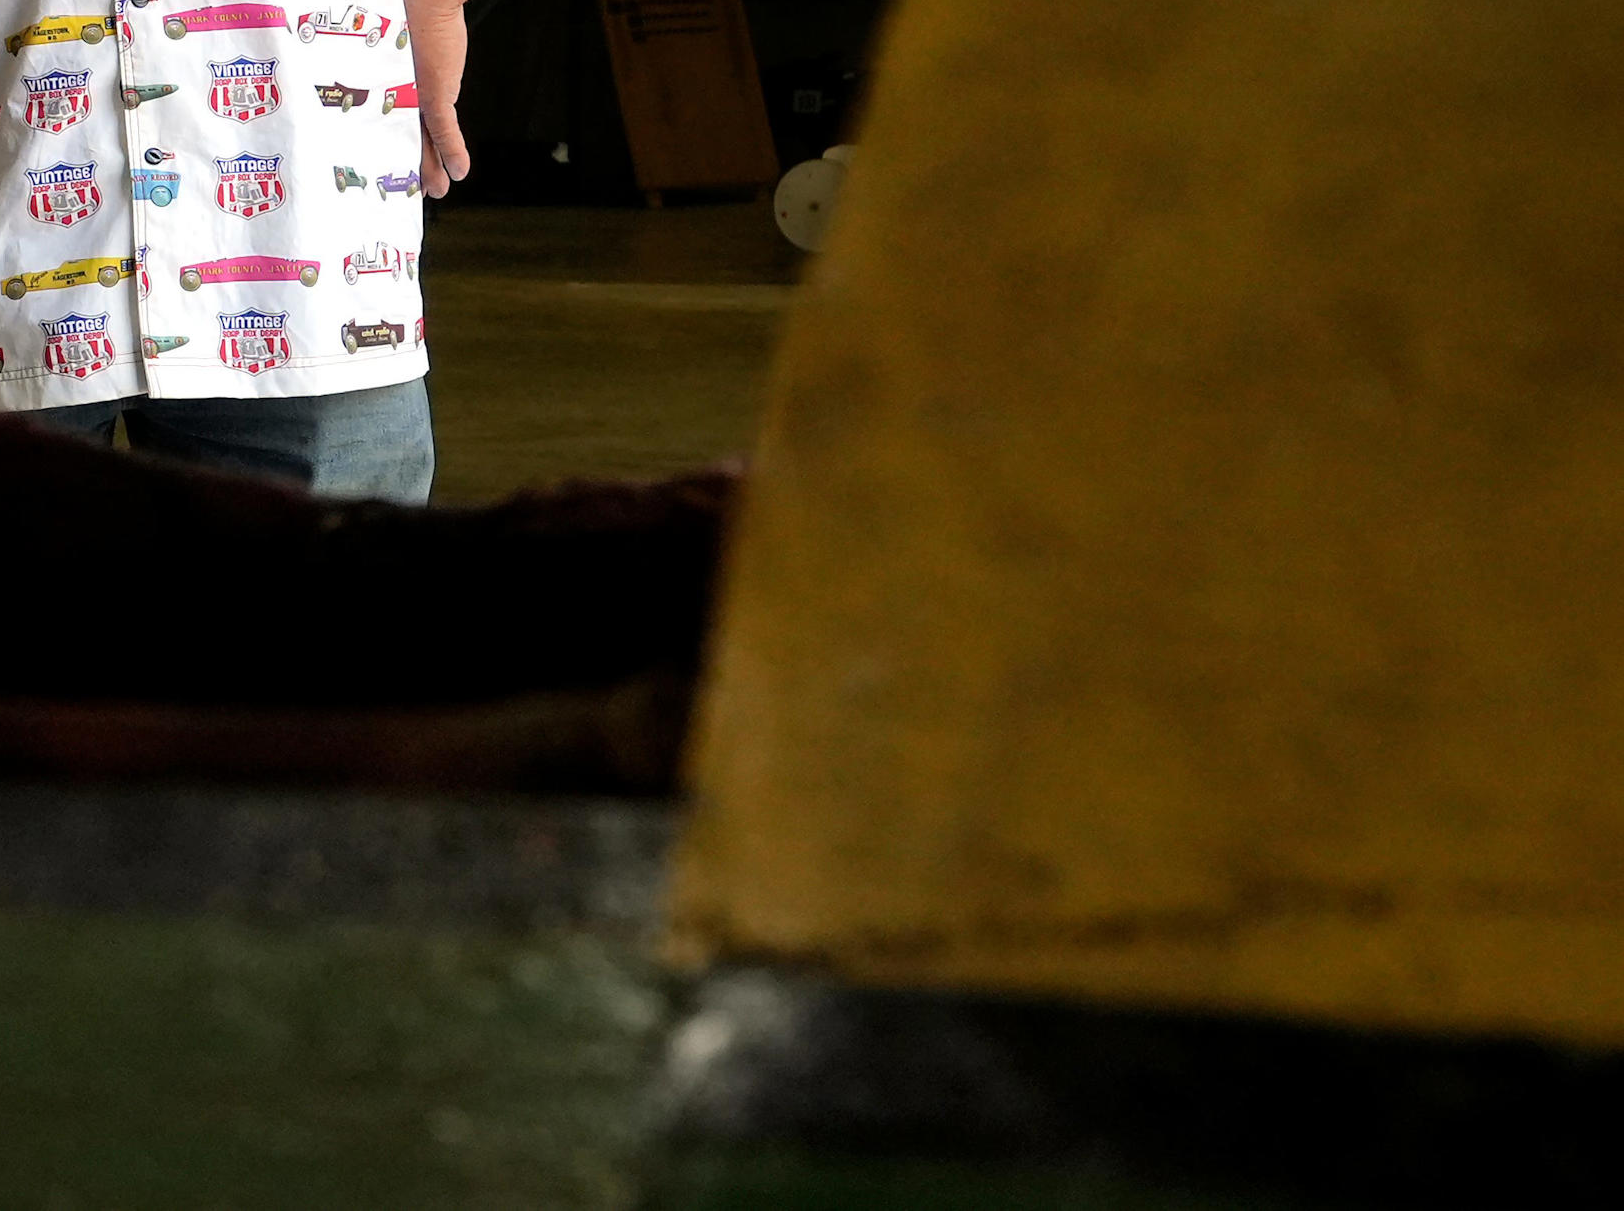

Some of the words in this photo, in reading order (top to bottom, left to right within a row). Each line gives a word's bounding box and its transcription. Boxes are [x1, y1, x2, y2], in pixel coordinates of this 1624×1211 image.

[214, 13, 250, 22] COUNTY
[318, 13, 328, 25] 71
[214, 64, 271, 77] VINTAGE
[27, 75, 85, 92] VINTAGE
[220, 159, 276, 173] VINTAGE
[31, 166, 91, 185] VINTAGE
[227, 265, 262, 274] COUNTY
[45, 318, 103, 335] VINTAGE
[222, 316, 282, 329] VINTAGE
